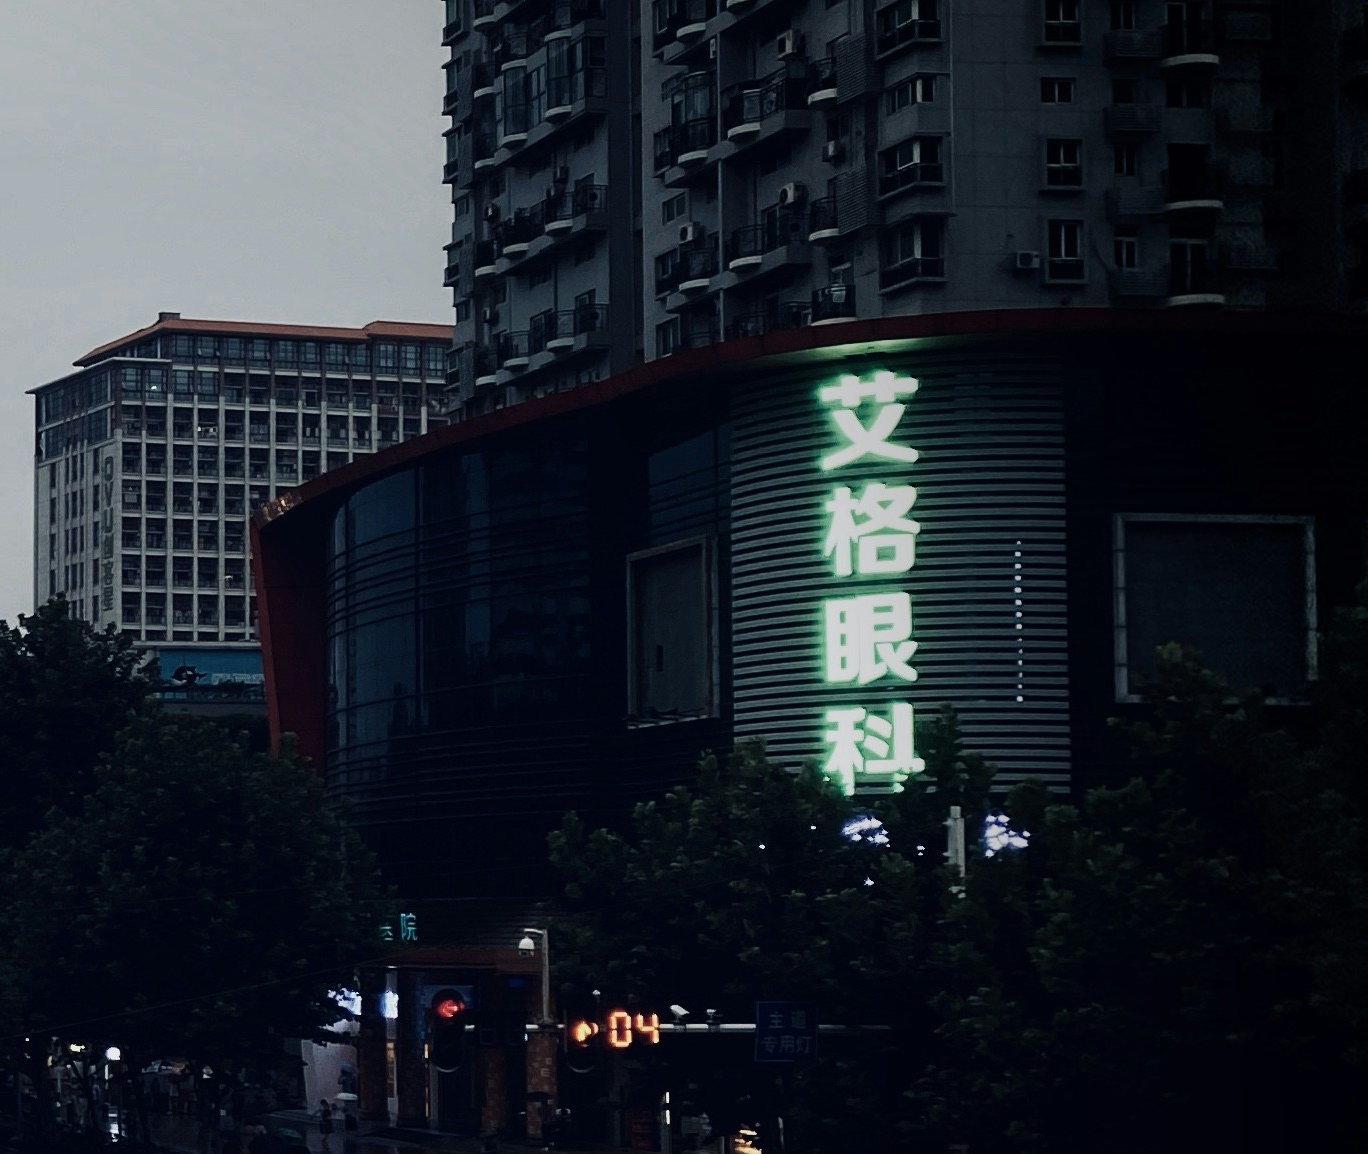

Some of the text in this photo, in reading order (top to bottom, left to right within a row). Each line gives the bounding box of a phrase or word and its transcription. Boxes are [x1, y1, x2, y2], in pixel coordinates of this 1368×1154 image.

[819, 370, 925, 796] 艾格眼科
[608, 1010, 660, 1048] 04
